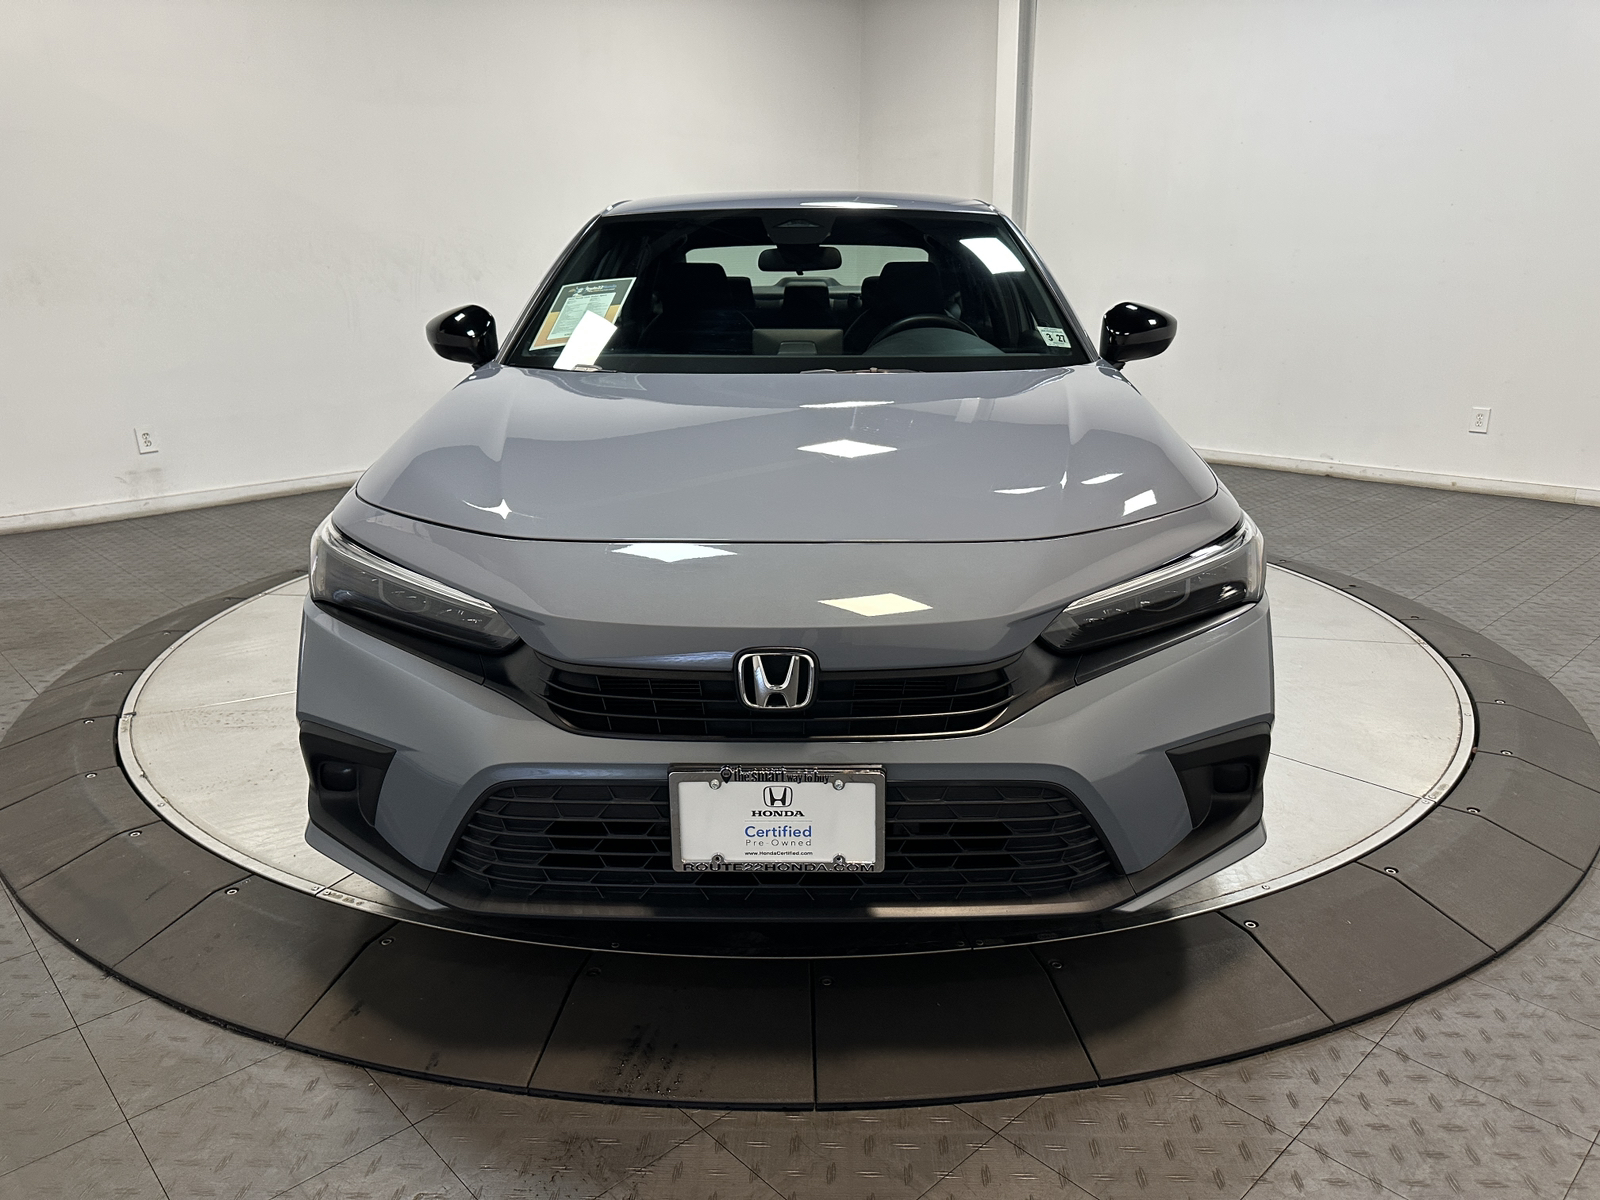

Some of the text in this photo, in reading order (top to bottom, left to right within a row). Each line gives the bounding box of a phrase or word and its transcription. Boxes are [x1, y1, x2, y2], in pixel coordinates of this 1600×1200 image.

[1046, 333, 1066, 342] 3 27
[751, 767, 786, 782] smart
[786, 773, 803, 784] way
[804, 771, 813, 782] to
[814, 769, 830, 784] buy
[744, 825, 813, 838] Certified
[745, 838, 812, 847] Pre-Owned
[682, 862, 875, 872] ROUTE22HONDA.COM
